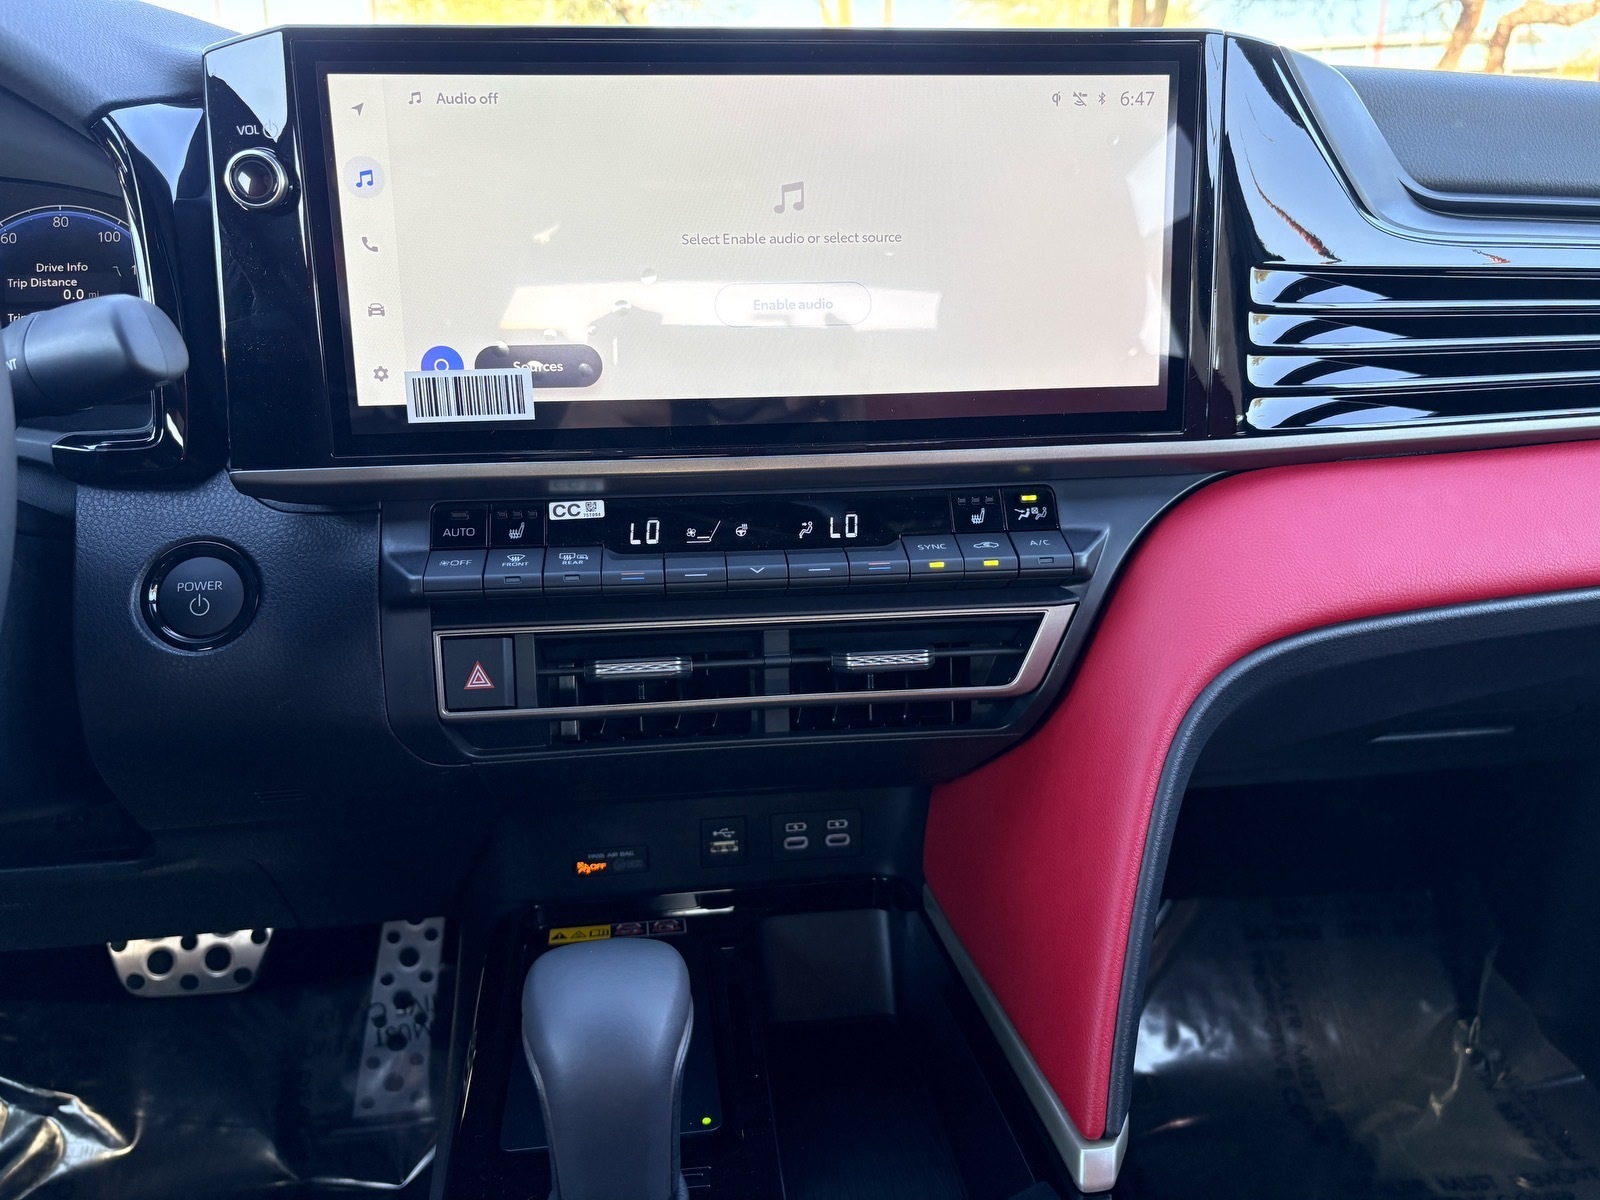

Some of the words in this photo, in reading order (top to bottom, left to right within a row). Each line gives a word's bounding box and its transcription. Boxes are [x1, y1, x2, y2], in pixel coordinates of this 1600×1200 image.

[436, 92, 477, 105] Audio
[479, 92, 499, 105] off
[1119, 91, 1156, 107] 6:47
[236, 124, 260, 136] VOL
[52, 216, 69, 228] 80
[0, 232, 17, 244] 60
[97, 231, 121, 243] 100
[681, 233, 720, 245] Select
[723, 233, 766, 245] Enable
[769, 232, 805, 244] audio
[807, 234, 821, 244] or
[823, 232, 860, 243] select
[862, 232, 903, 243] source
[36, 262, 64, 272] Drive
[67, 262, 88, 272] Info
[7, 278, 28, 290] Trip
[30, 277, 78, 288] Distance
[63, 288, 84, 300] 0.0
[88, 290, 100, 298] mi
[753, 298, 796, 311] Enable
[798, 297, 834, 311] audio
[552, 503, 581, 518] CC
[442, 527, 476, 538] AUTO
[917, 543, 947, 551] SYNC
[1029, 539, 1051, 547] A/C
[450, 559, 473, 567] OFF
[176, 580, 223, 592] POWER
